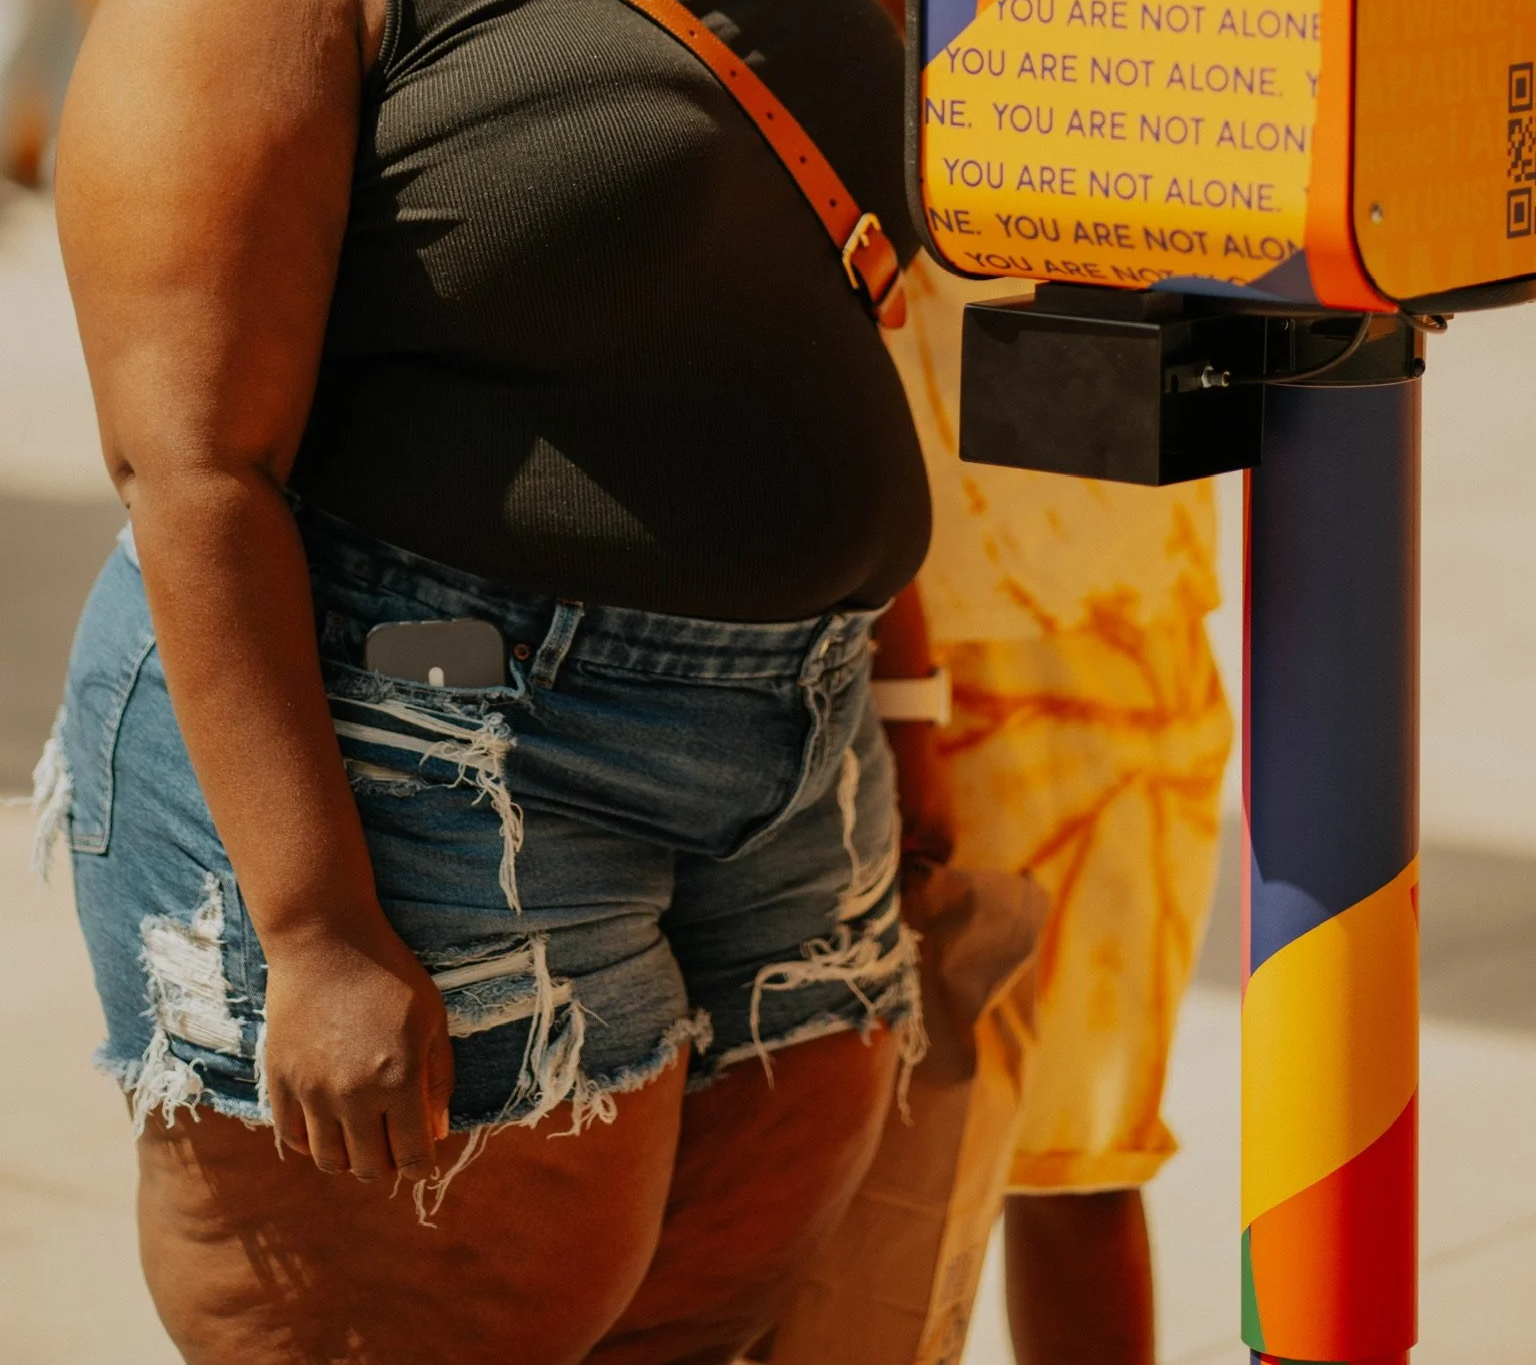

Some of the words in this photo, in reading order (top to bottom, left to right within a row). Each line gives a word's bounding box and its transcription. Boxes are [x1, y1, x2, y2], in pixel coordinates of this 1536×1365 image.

[1067, 0, 1127, 29] ARE
[1142, 4, 1205, 33] NOT
[946, 47, 1005, 77] YOU
[1017, 52, 1077, 82] ARE
[1091, 57, 1154, 87] NOT
[1167, 63, 1283, 97] ALONE.
[992, 102, 1053, 134] YOU
[1066, 109, 1126, 140] ARE
[1140, 114, 1204, 145] NOT
[1217, 120, 1306, 153] ALON
[944, 158, 1003, 189] YOU
[1016, 165, 1076, 195] ARE
[1090, 170, 1152, 202] NOT
[1165, 178, 1281, 212] ALONE.
[996, 212, 1060, 243] YOU
[1074, 220, 1135, 250] ARE
[1143, 226, 1208, 256] NOT
[964, 251, 1033, 272] YOU
[1044, 259, 1108, 280] ARE
